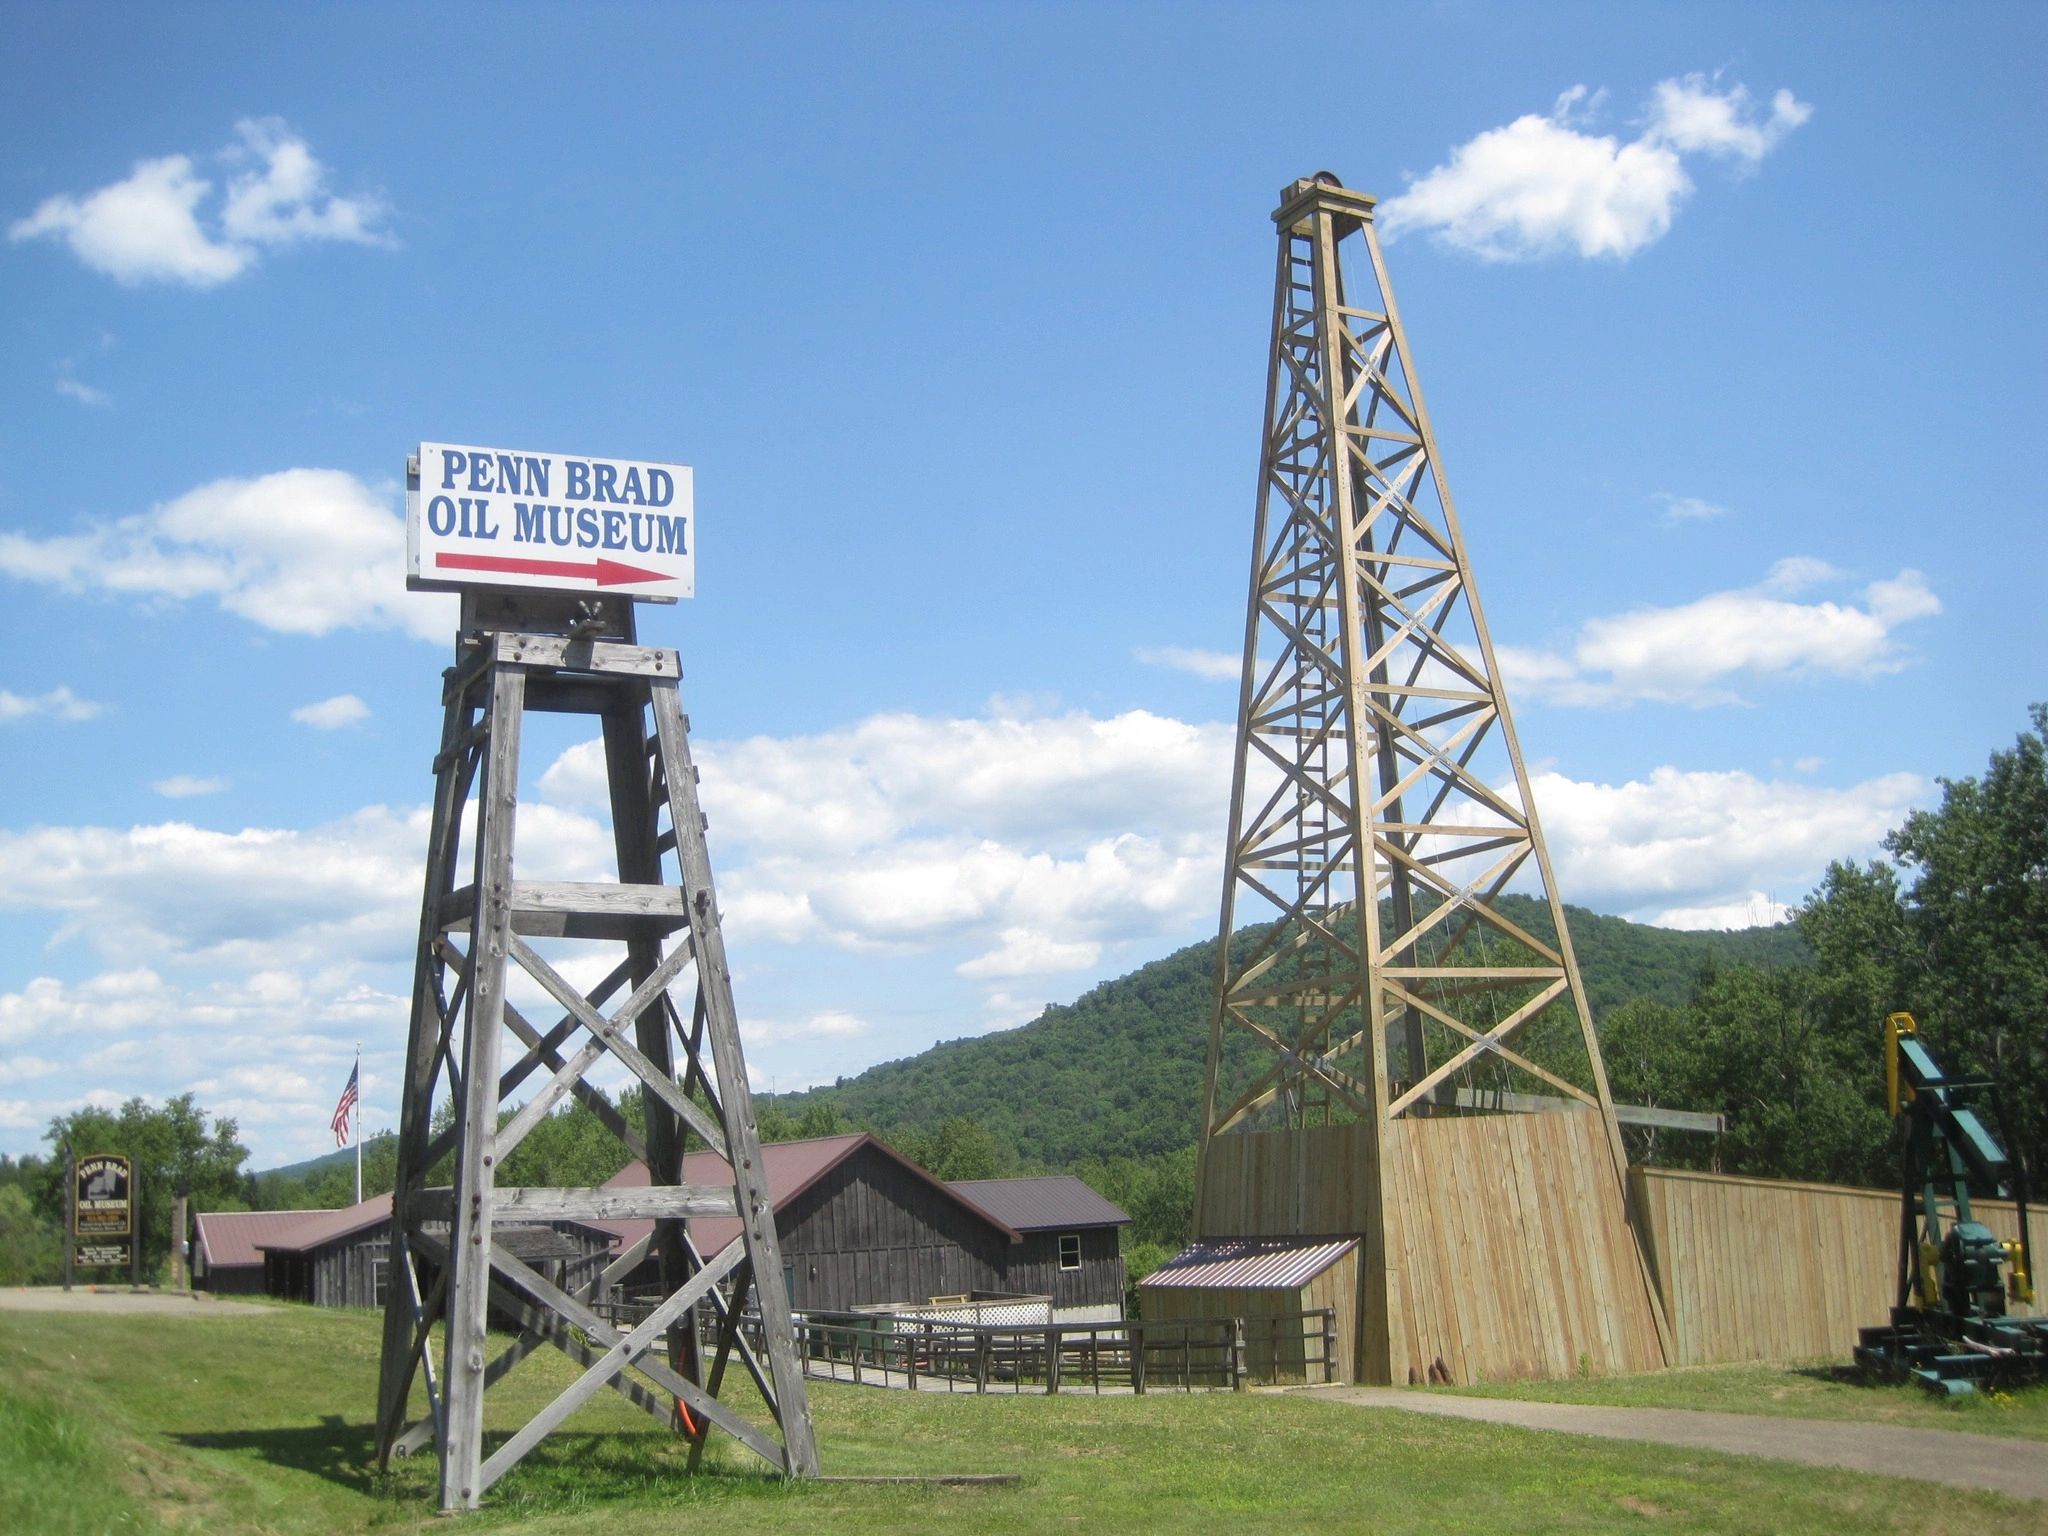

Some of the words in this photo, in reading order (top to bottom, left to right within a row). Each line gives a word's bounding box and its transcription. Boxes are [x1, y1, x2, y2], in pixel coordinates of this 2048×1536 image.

[441, 450, 550, 497] PENN
[565, 461, 674, 507] BRAD
[428, 495, 499, 539] OIL
[513, 503, 688, 555] MUSEUM
[80, 1161, 103, 1179] PENN
[105, 1161, 128, 1178] BRAD
[80, 1200, 92, 1209] OIL
[94, 1199, 128, 1209] MUSEUM
